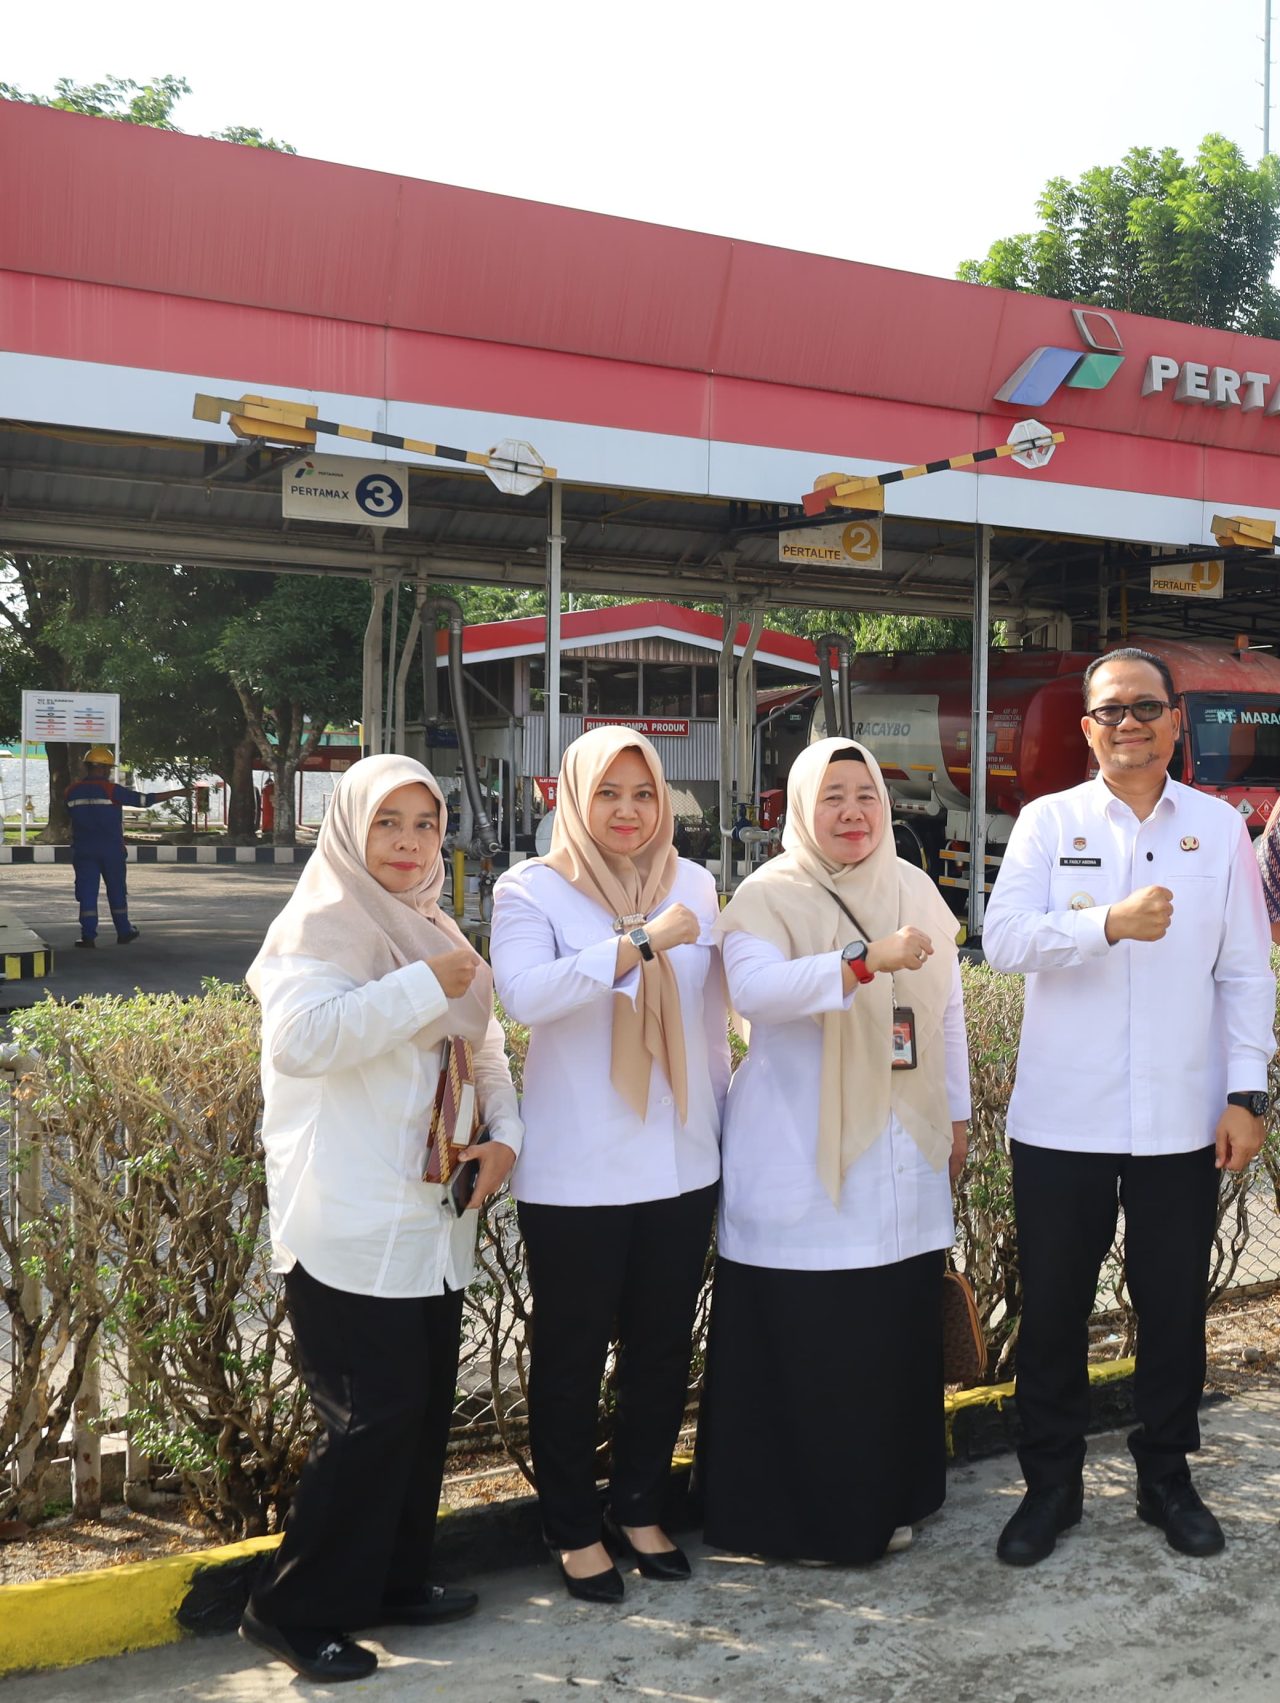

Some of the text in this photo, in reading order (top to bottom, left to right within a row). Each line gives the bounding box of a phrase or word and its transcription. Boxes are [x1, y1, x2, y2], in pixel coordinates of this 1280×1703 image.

[291, 485, 350, 500] PERTAMAX
[364, 480, 395, 513] 3
[850, 527, 871, 554] 2
[783, 545, 841, 560] PERTALITE
[1199, 561, 1212, 585] 1
[1153, 579, 1198, 592] PERTALITE
[1217, 711, 1237, 724] PT.
[651, 723, 685, 732] PRODUK
